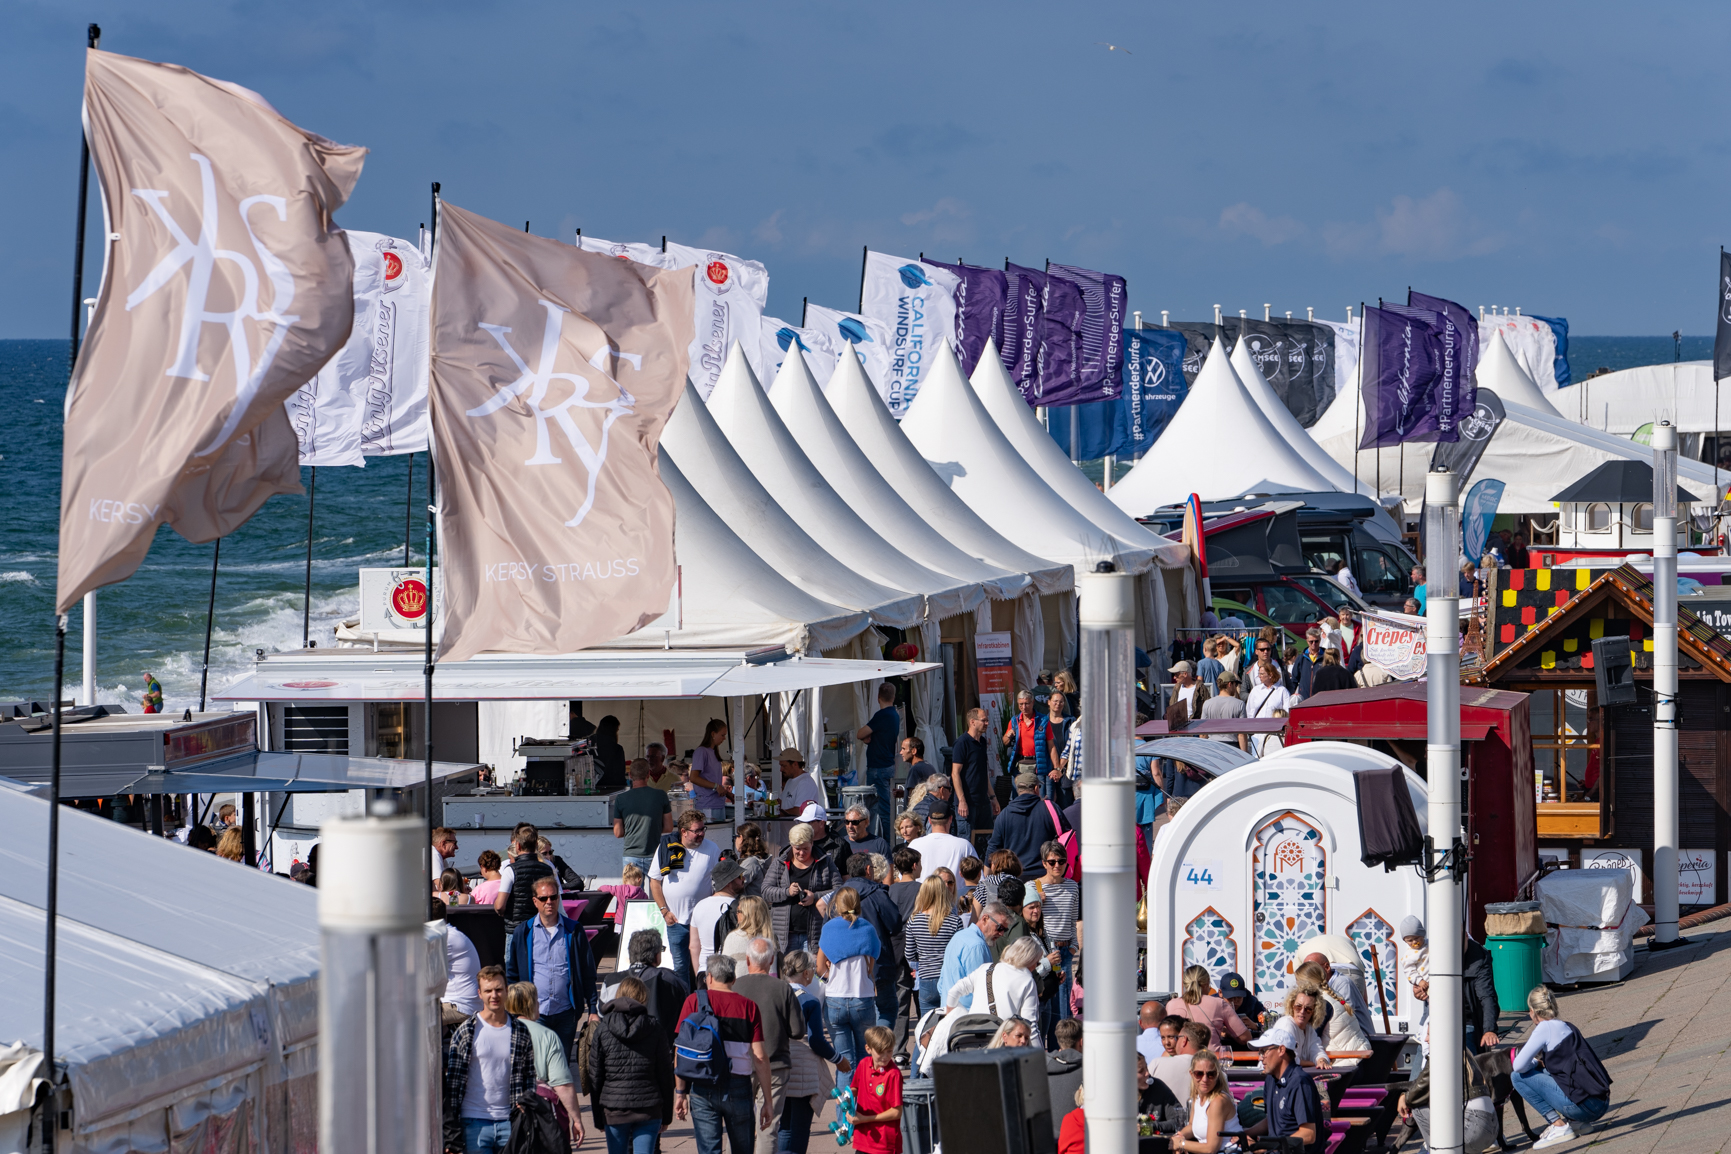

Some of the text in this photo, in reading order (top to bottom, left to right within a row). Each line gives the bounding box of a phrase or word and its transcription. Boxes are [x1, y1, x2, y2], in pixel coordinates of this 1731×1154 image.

[889, 296, 910, 411] WINDSURF CUP
[903, 296, 925, 411] CALIFORNIA
[1103, 281, 1122, 396] #PartnerderSurfer
[1129, 337, 1144, 440] #PartnerderSurfer
[1396, 320, 1412, 436] California
[89, 498, 160, 525] KERSY
[485, 558, 640, 583] KERSY STRAUSS
[977, 641, 1010, 650] Infrarotkabinen
[1367, 628, 1414, 647] Crêpes
[1187, 868, 1213, 885] 44
